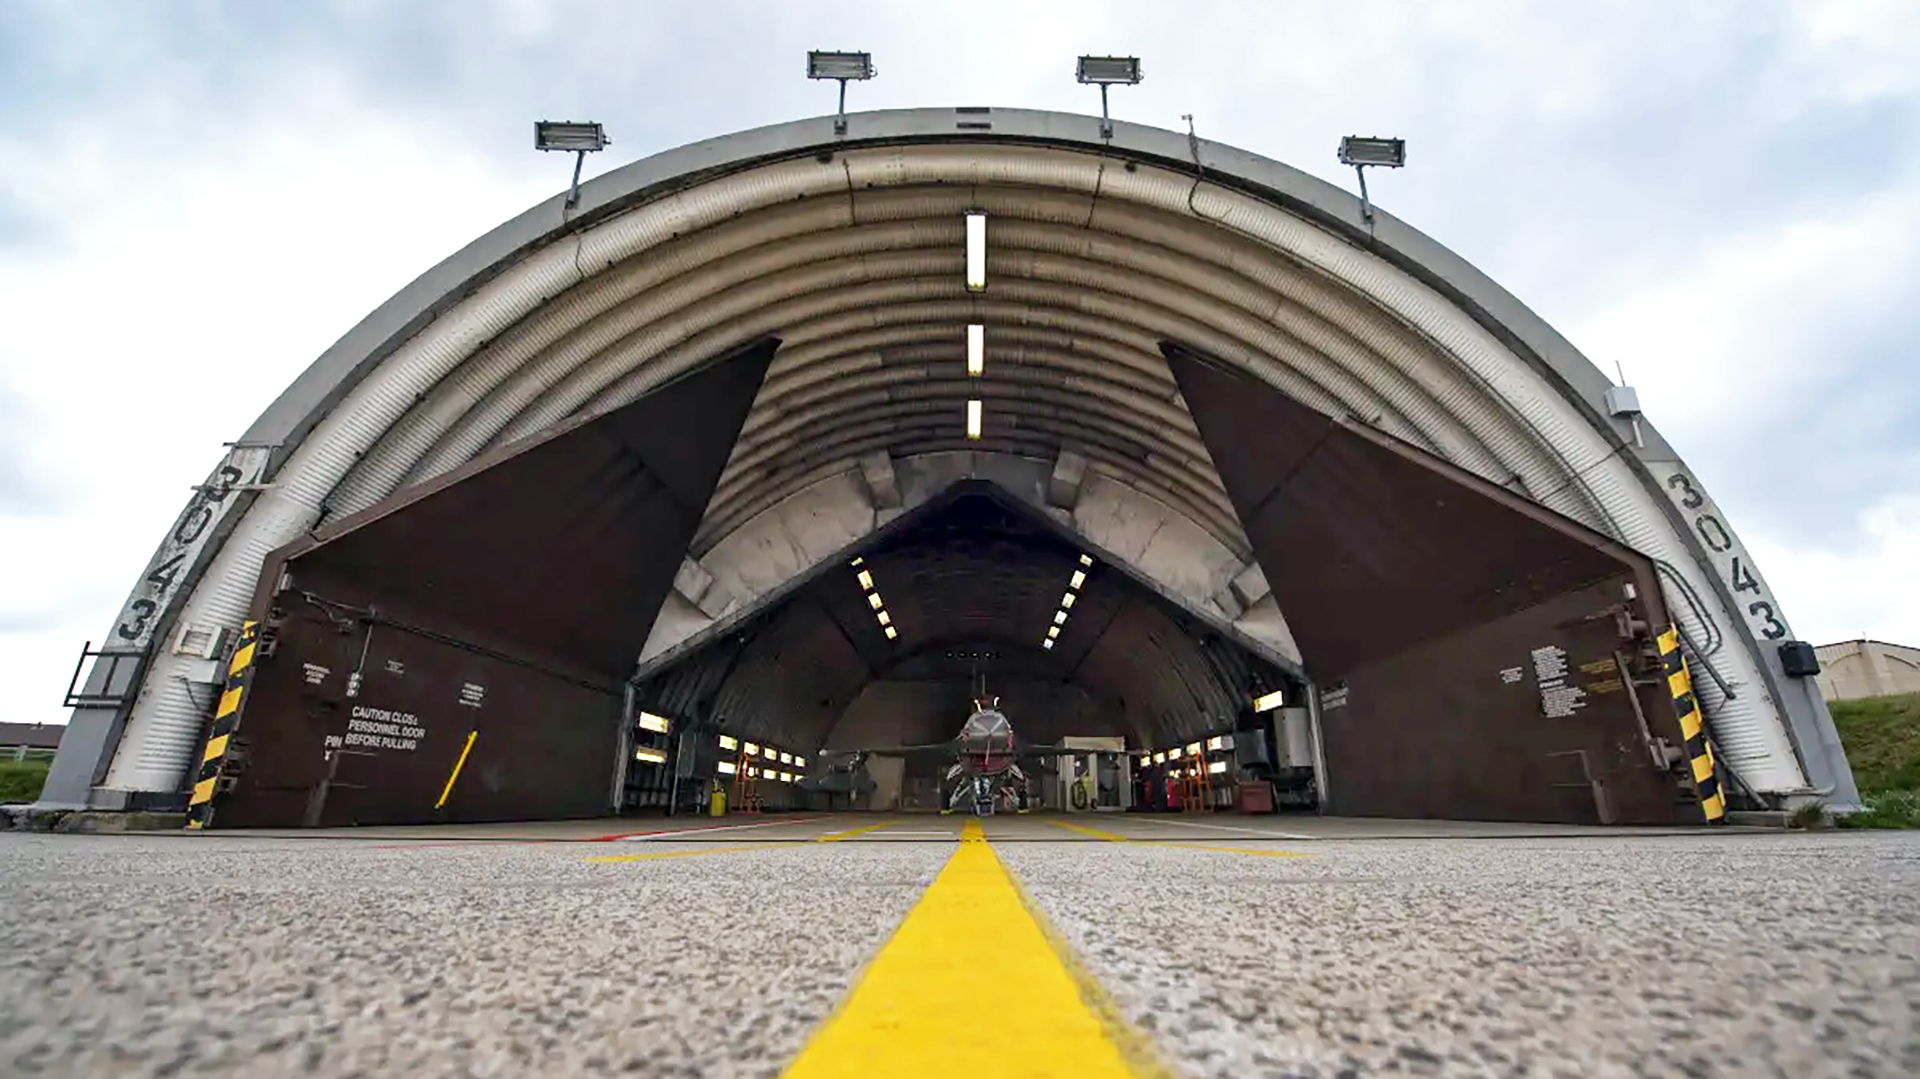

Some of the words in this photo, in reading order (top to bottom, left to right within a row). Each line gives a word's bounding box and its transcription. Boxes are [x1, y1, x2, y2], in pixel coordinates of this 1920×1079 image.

[1667, 473, 1786, 640] 3043
[352, 706, 392, 721] CAUTION
[348, 719, 400, 736] PERSONNEL
[402, 726, 426, 738] DOOR
[325, 735, 343, 747] PIN
[345, 732, 381, 747] BEFORE
[381, 737, 416, 750] PULLING
